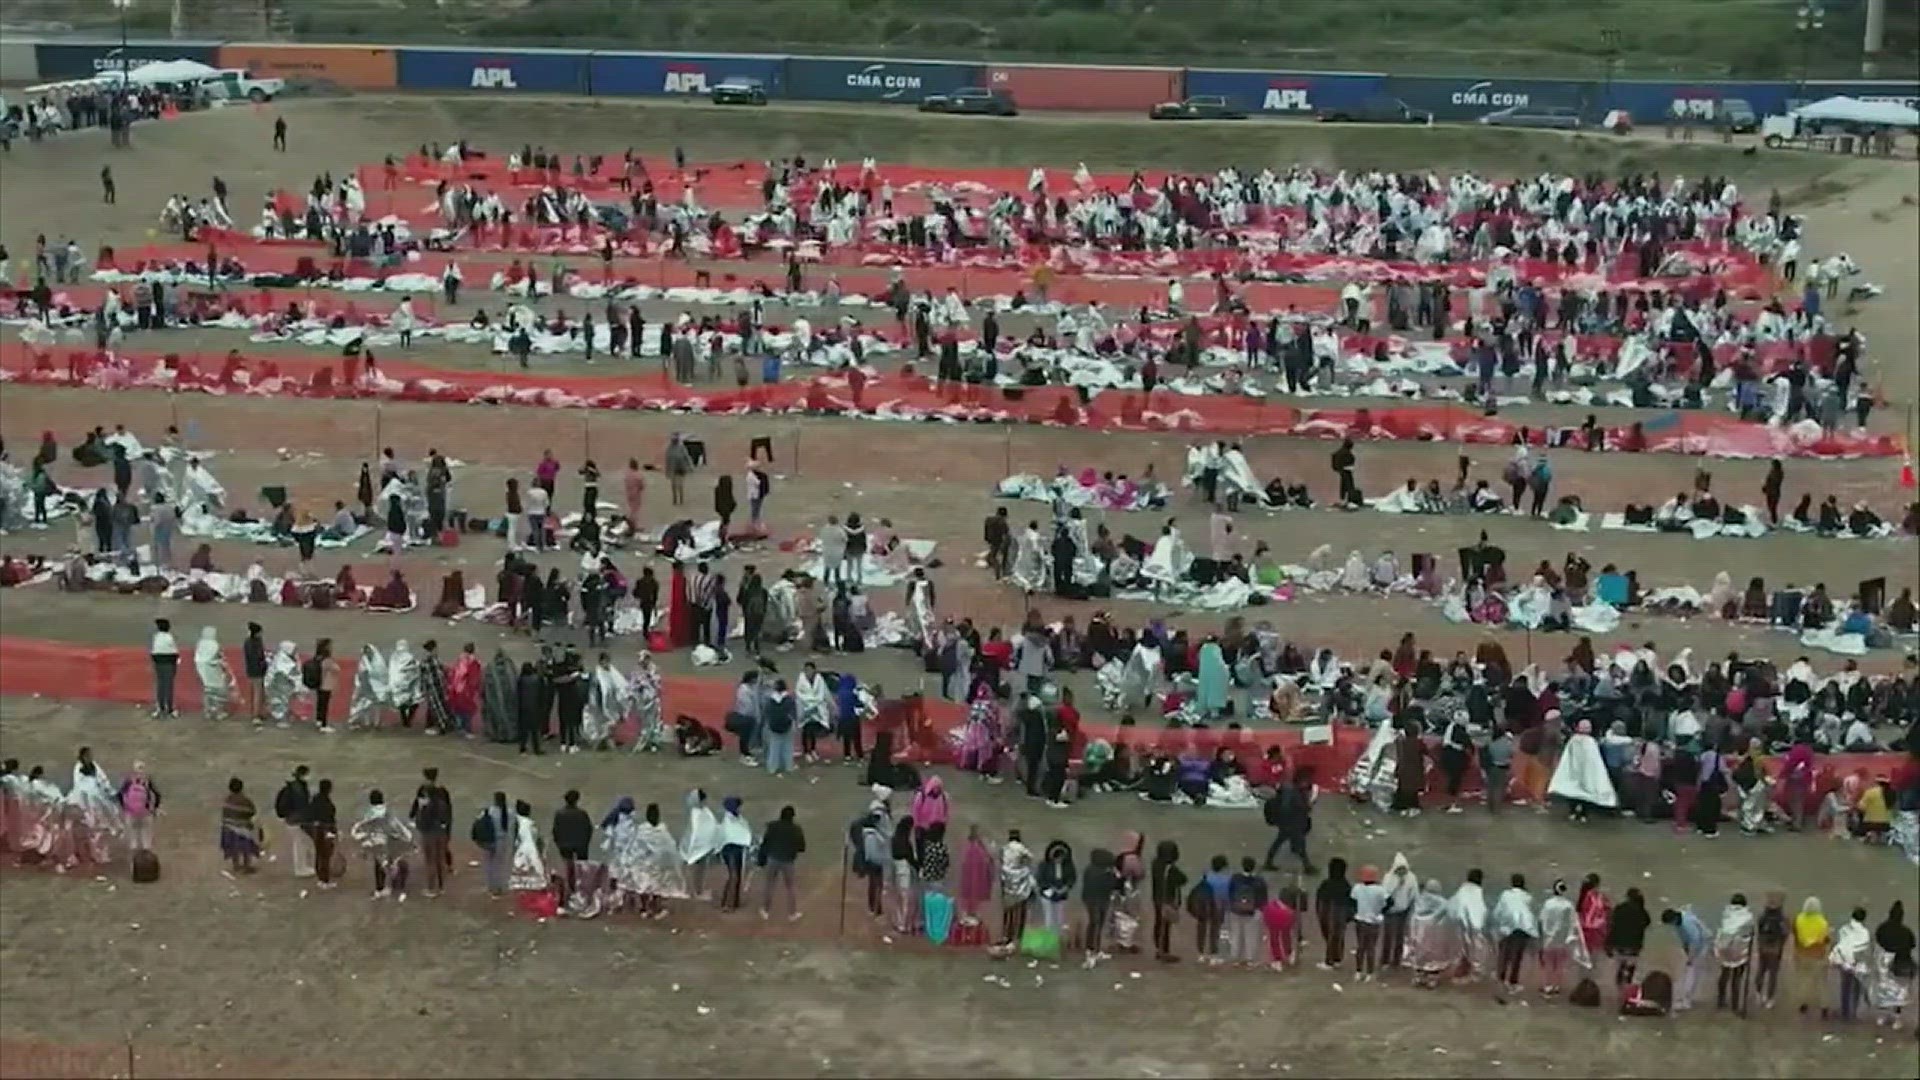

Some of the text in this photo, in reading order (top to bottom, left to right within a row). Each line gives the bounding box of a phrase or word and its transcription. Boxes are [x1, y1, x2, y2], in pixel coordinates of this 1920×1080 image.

[471, 67, 517, 87] APL
[664, 72, 711, 93] APL
[847, 74, 881, 86] CMA
[1263, 89, 1312, 110] APL
[1452, 92, 1488, 104] CMA
